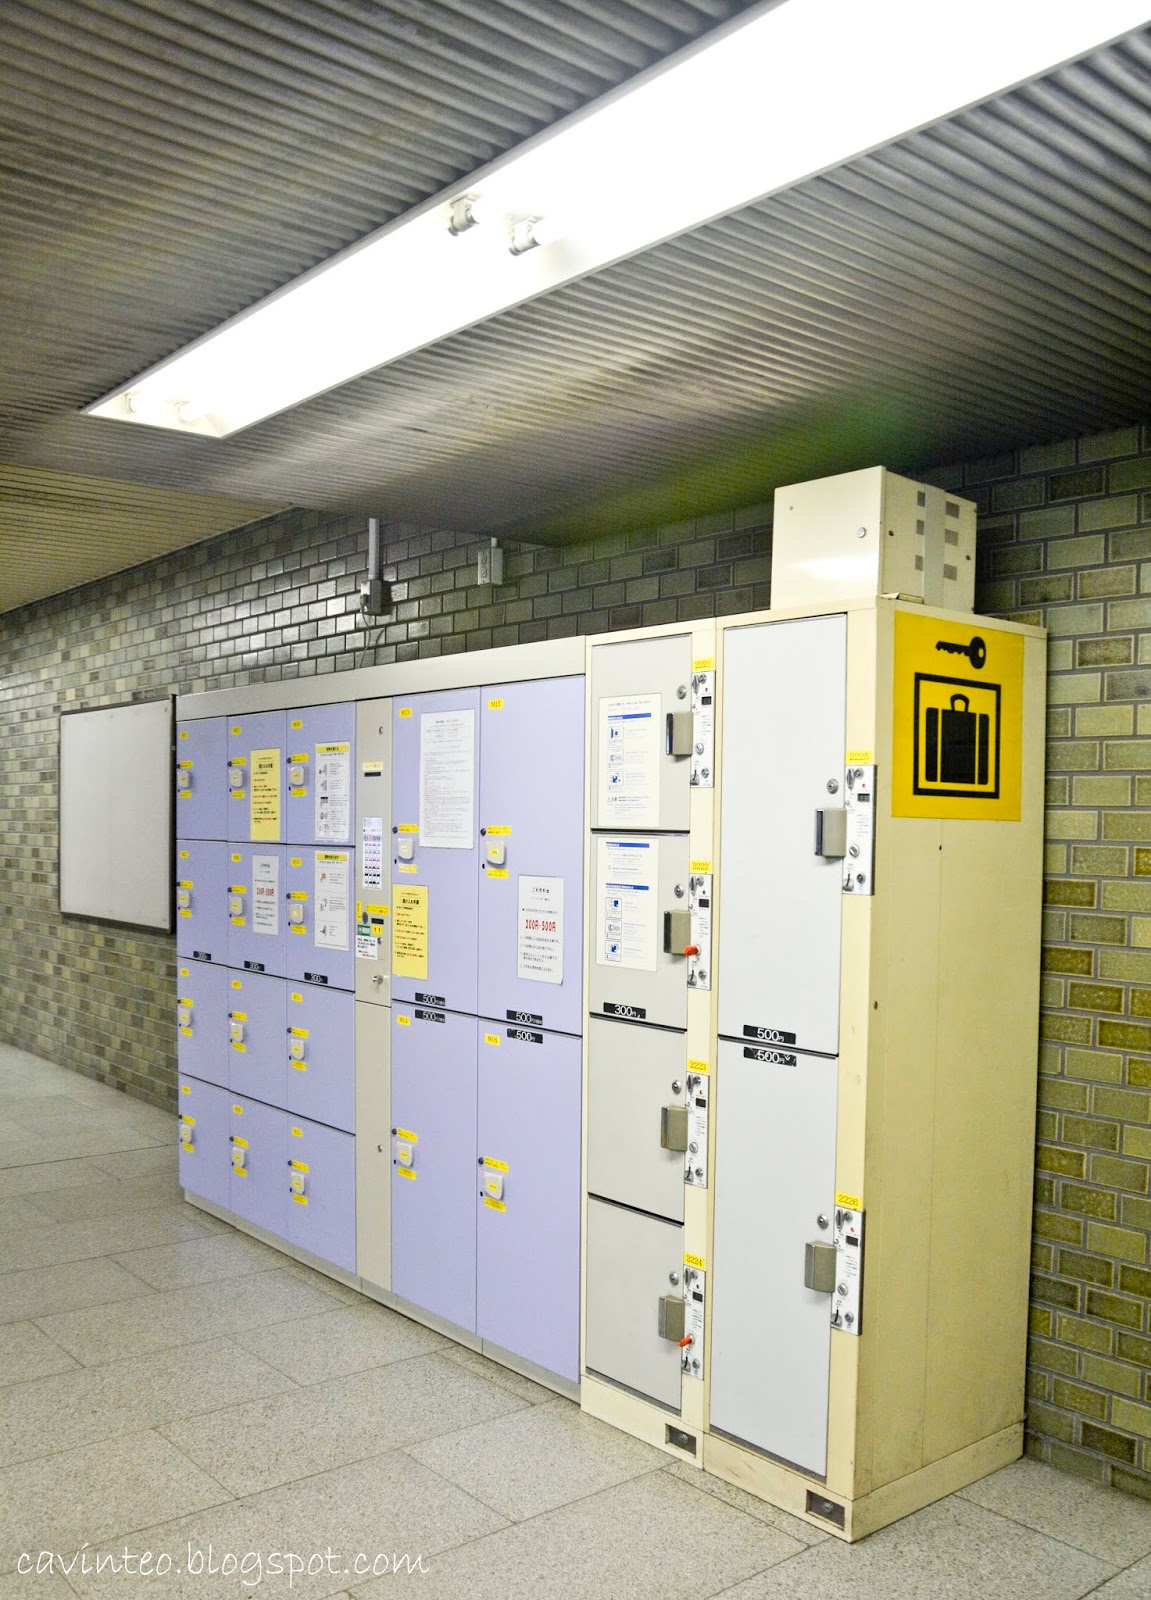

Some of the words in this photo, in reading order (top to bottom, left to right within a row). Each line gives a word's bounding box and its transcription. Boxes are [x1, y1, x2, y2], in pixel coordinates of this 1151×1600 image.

[695, 660, 711, 669] 2221
[849, 752, 870, 761] 2225
[692, 861, 709, 871] 2222
[757, 1027, 785, 1042] 500円
[690, 1061, 707, 1071] 2223
[838, 1194, 859, 1207] 2226
[685, 1253, 702, 1267] 2224
